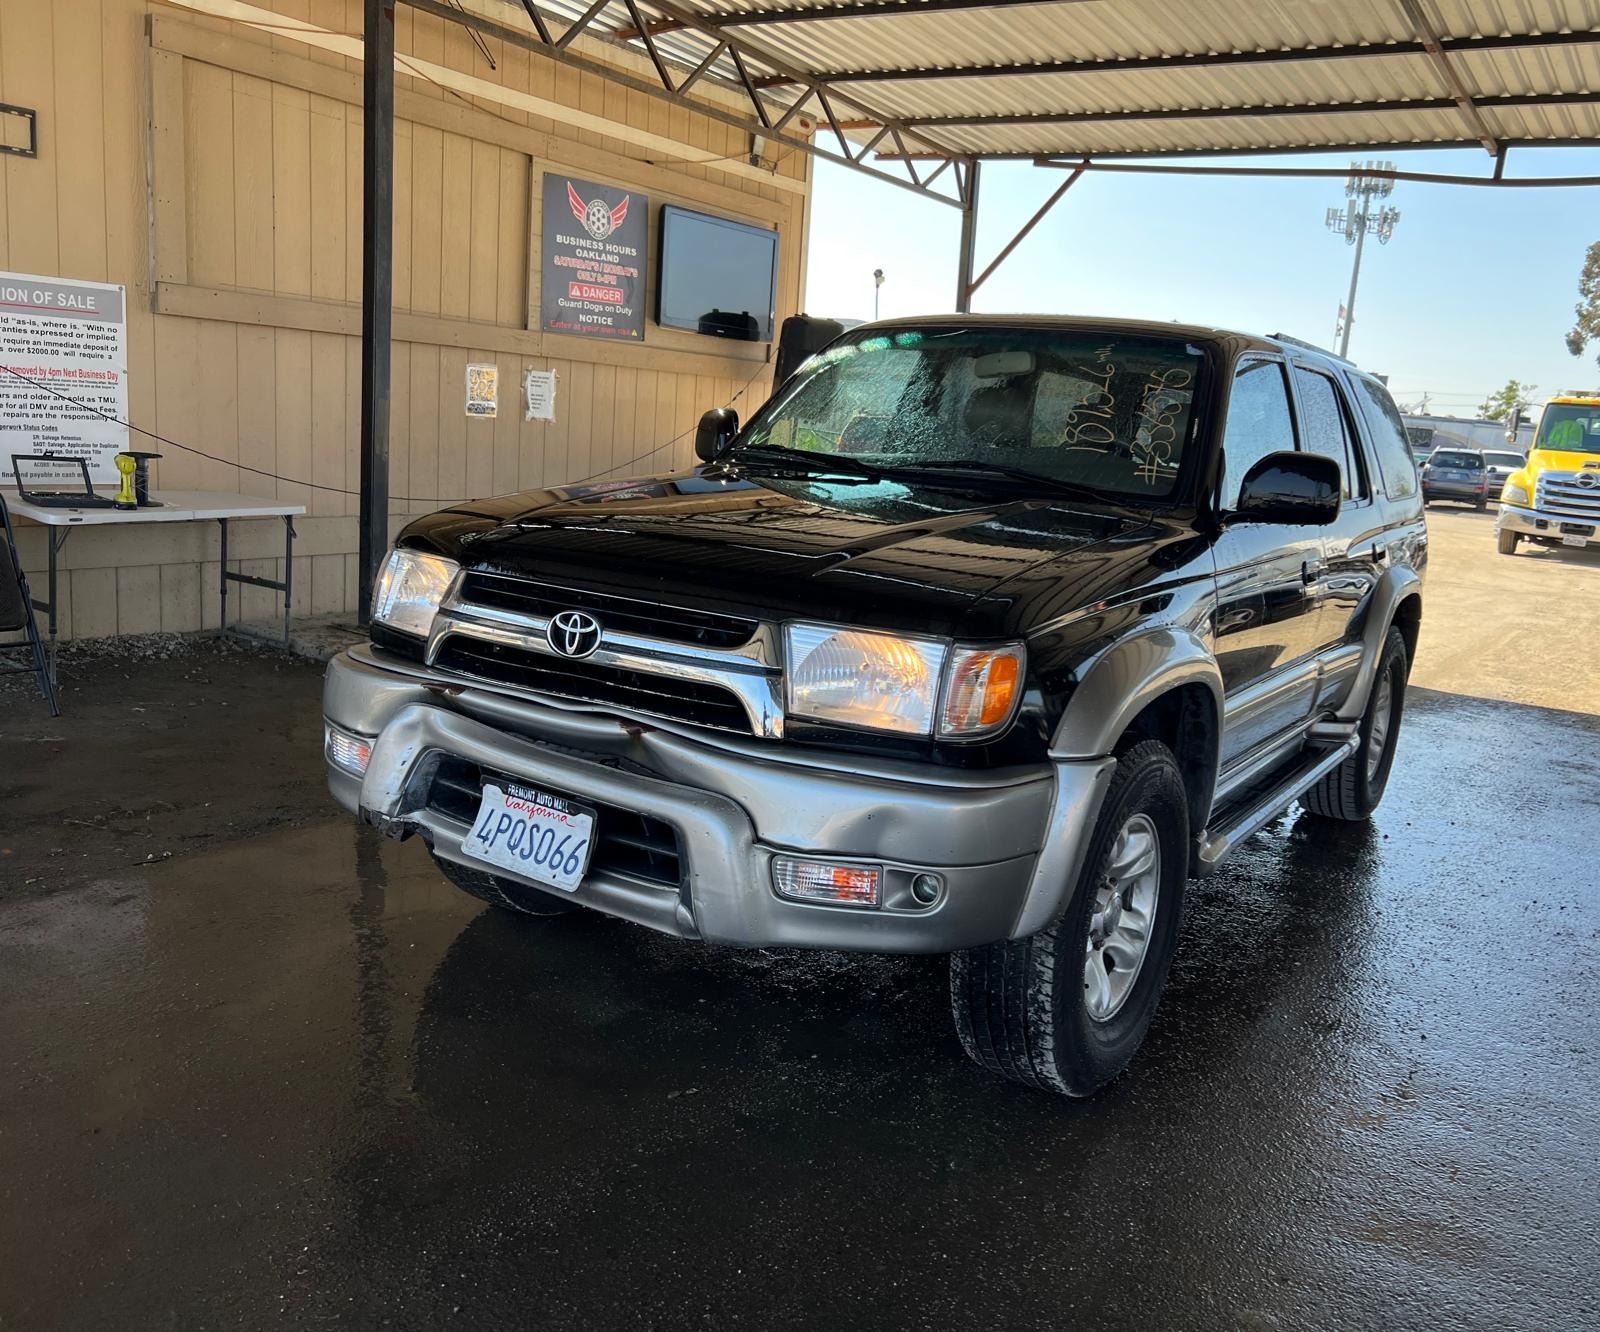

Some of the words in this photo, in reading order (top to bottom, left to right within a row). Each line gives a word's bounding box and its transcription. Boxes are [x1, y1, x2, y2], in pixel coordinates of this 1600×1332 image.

[556, 235, 603, 250] BUSINESS
[606, 243, 636, 256] HOURS
[576, 249, 619, 263] OAKLAND
[1, 287, 28, 303] ION
[32, 290, 53, 305] OF
[57, 293, 96, 310] SALE
[583, 287, 620, 301] DANGER
[558, 298, 582, 308] Guard
[584, 301, 603, 313] Dogs
[616, 305, 632, 316] Duty
[42, 321, 67, 329] where
[579, 314, 613, 325] NOTICE
[30, 328, 73, 339] expressed
[3, 338, 30, 348] require
[43, 338, 81, 350] immediate
[82, 343, 110, 353] deposit
[110, 345, 118, 353] of
[26, 347, 59, 356] $2000.00
[79, 351, 104, 361] require
[39, 367, 47, 378] by
[48, 368, 61, 376] 4pm
[63, 368, 77, 378] Next
[79, 369, 106, 379] Business
[107, 371, 118, 382] Day
[30, 393, 51, 401] older
[3, 412, 30, 420] repairs
[60, 414, 109, 422] responsibility
[23, 424, 40, 432] Status
[508, 784, 535, 801] FREMONT
[537, 793, 553, 807] AUTO
[554, 798, 569, 812] MALL
[505, 795, 575, 828] California
[476, 808, 587, 876] 4PQS066
